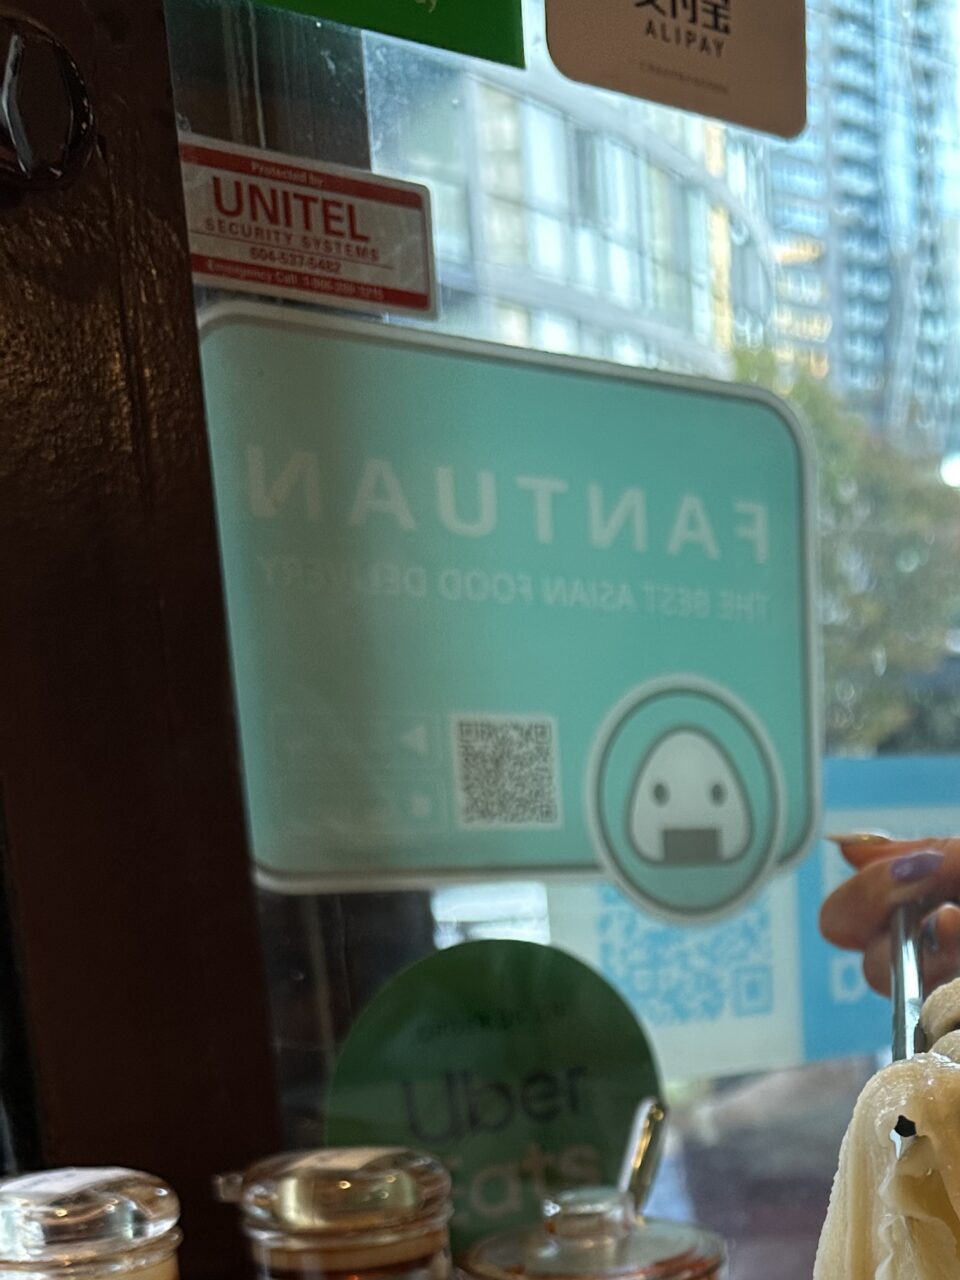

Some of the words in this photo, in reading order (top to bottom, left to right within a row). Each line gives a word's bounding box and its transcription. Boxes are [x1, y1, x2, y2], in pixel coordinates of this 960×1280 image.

[645, 18, 725, 58] ALIPAY
[212, 175, 371, 243] UNITEL
[204, 217, 293, 246] SECURITY
[302, 236, 380, 263] SYSTEMS
[400, 1064, 590, 1145] Uber
